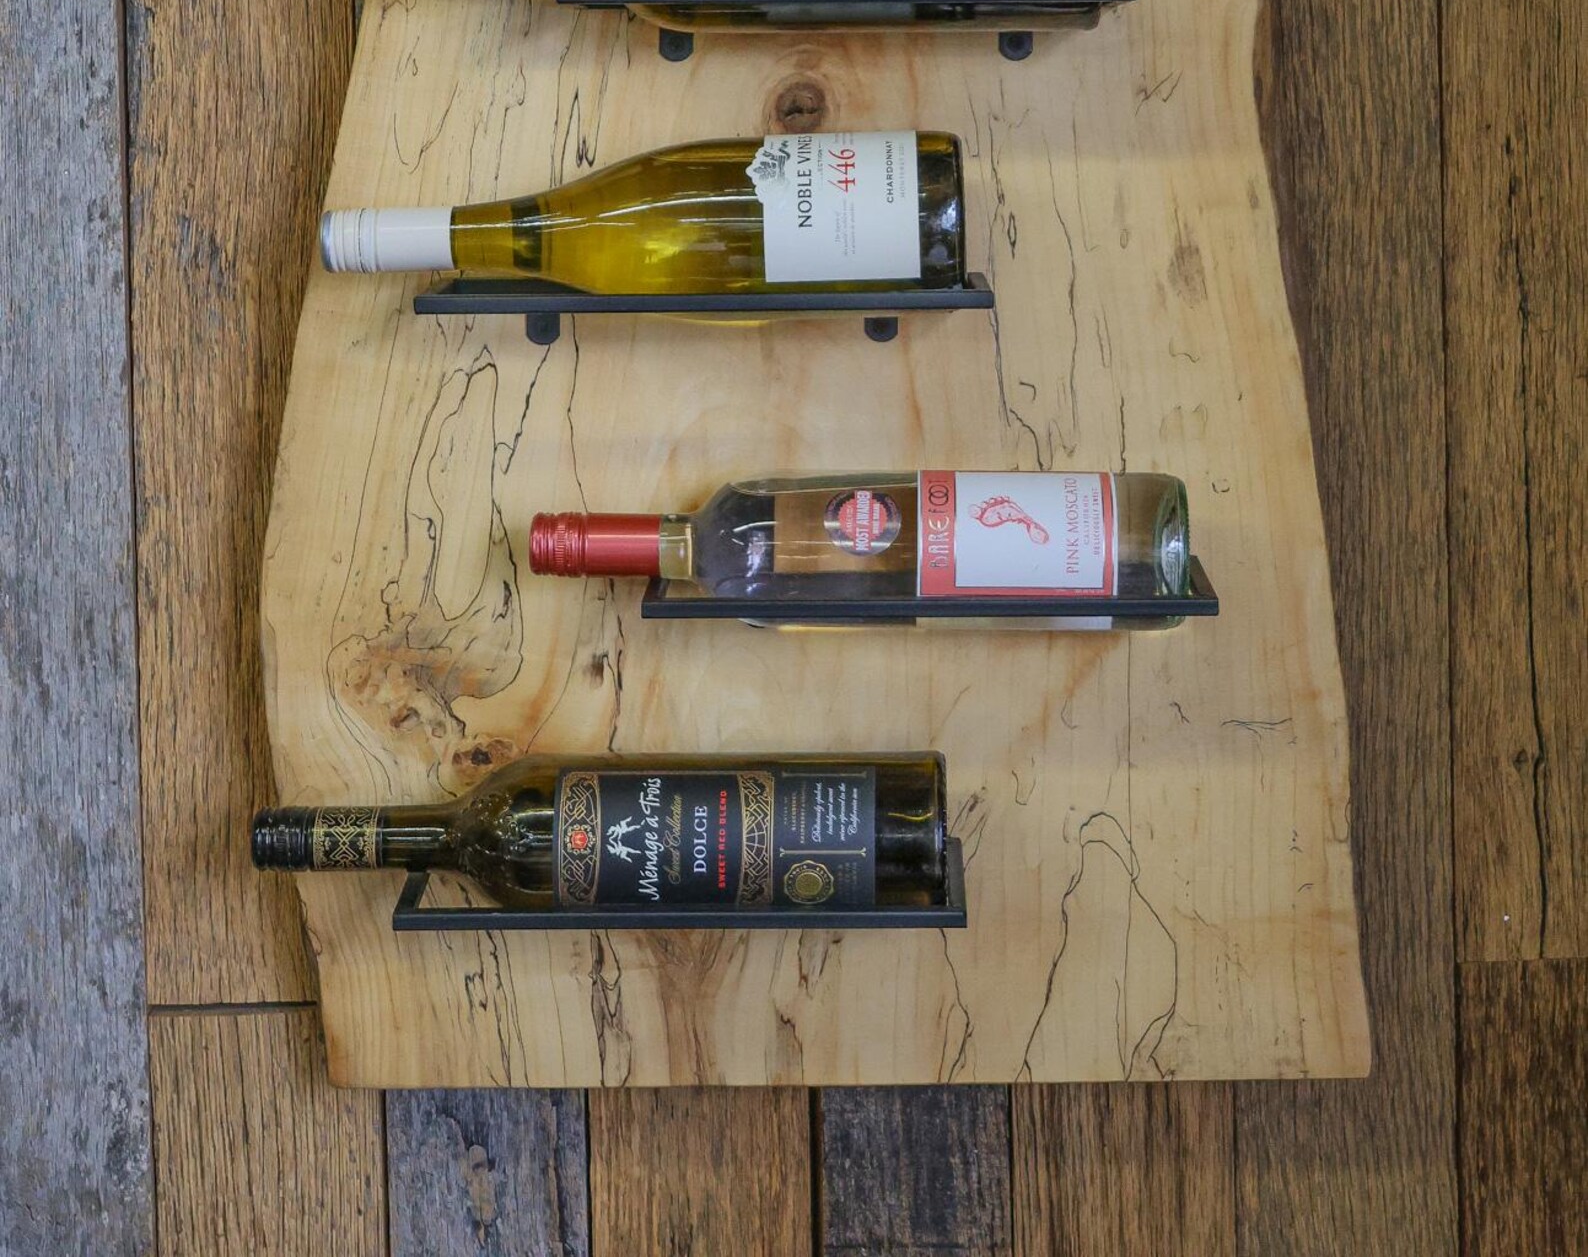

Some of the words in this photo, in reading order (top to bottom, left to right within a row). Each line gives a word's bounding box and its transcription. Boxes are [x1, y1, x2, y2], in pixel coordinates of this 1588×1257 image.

[797, 135, 812, 163] VINES
[827, 148, 856, 192] 446
[885, 140, 894, 203] CHARDONNAY
[797, 169, 813, 227] NOBLE
[854, 490, 870, 524] AWARDED
[1064, 477, 1080, 532] MOSCATO
[854, 528, 869, 550] MOST
[927, 479, 950, 567] BAREFOOT
[1065, 537, 1080, 573] PINK
[638, 777, 661, 814] Trois
[719, 790, 728, 824] BLEND
[641, 815, 659, 827] à
[662, 793, 682, 847] Collection
[693, 805, 708, 873] DOLCE
[718, 828, 727, 850] RED
[638, 831, 664, 900] Ménage
[662, 848, 681, 884] Sweet
[718, 853, 727, 888] SWEET
